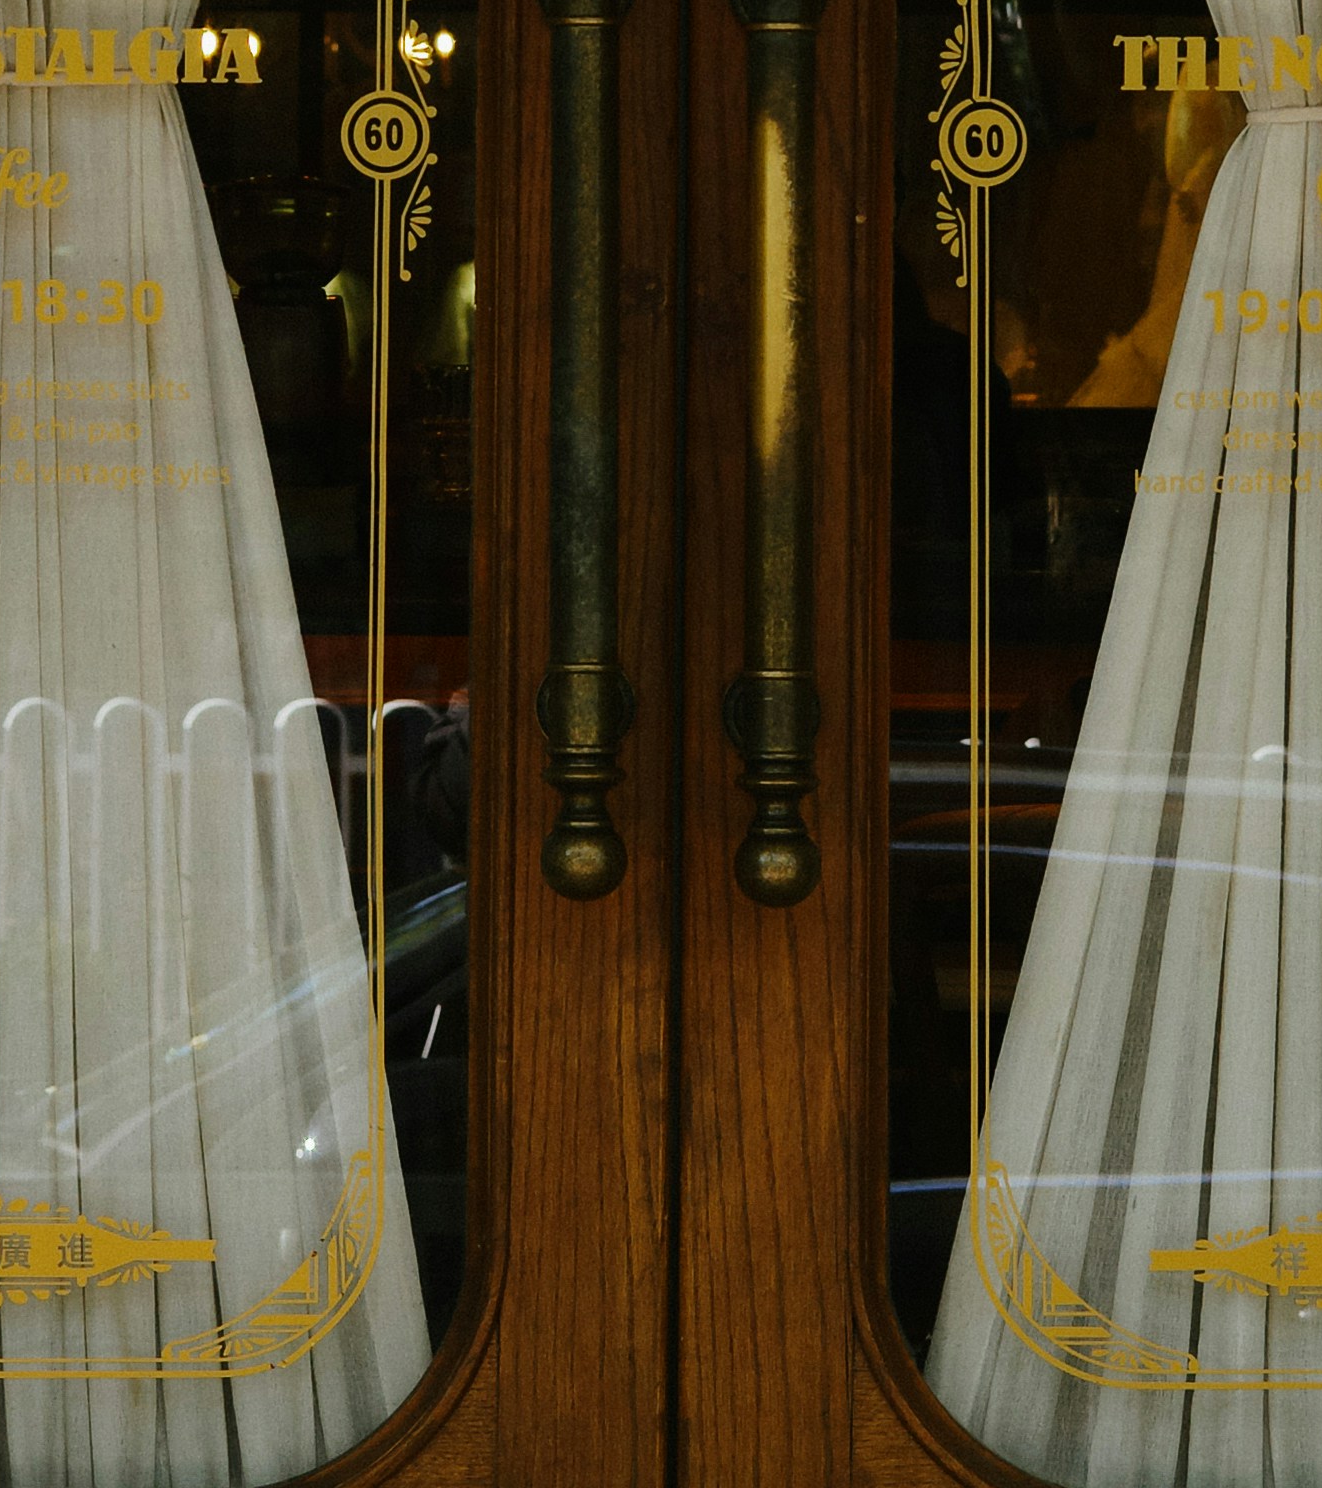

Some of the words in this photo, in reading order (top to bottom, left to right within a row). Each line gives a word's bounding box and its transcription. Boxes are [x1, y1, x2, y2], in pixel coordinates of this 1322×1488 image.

[1112, 34, 1258, 93] THE
[364, 117, 404, 152] 60
[965, 124, 1005, 159] 60
[17, 376, 120, 400] dresses
[127, 377, 190, 401] suits
[1173, 388, 1278, 410] custom
[40, 459, 143, 490] vintage
[152, 460, 232, 490] styles
[1133, 468, 1206, 494] hand
[1212, 468, 1313, 495] crafted
